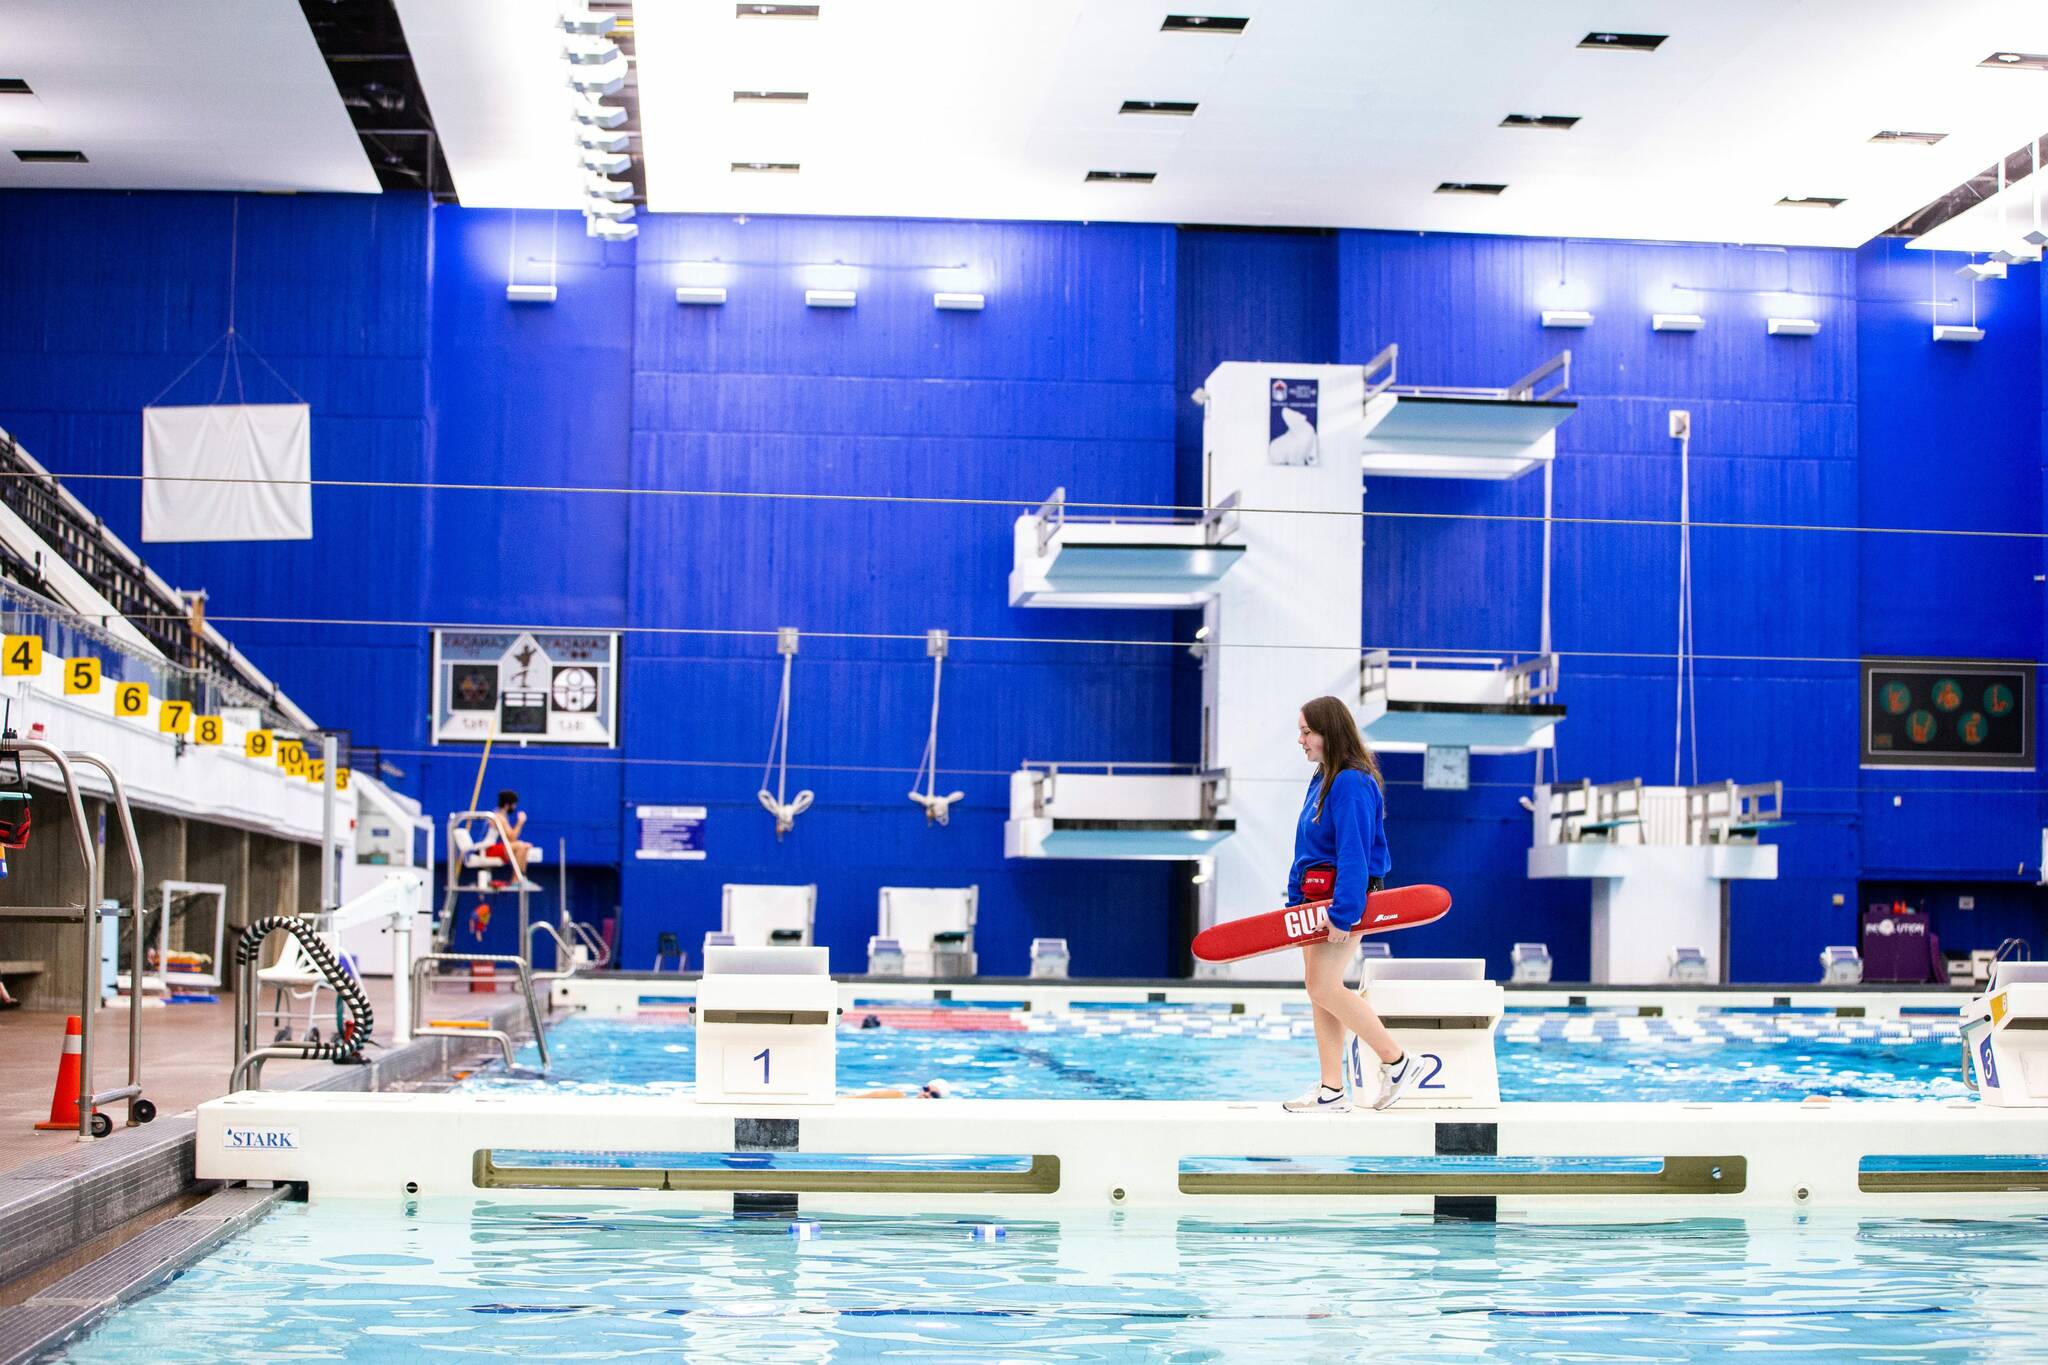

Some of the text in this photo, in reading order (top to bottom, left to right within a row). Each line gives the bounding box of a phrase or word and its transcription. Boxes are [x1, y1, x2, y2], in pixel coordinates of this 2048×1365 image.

[11, 641, 33, 671] 4
[73, 662, 93, 690] 5
[123, 687, 141, 712] 6
[168, 705, 184, 729] 7
[202, 720, 217, 742] 8
[251, 733, 266, 755] 9
[279, 744, 301, 765] 10
[753, 1047, 771, 1085] 1
[1417, 1053, 1446, 1089] 2
[1984, 1048, 1993, 1080] 3
[232, 1131, 293, 1147] STARK
